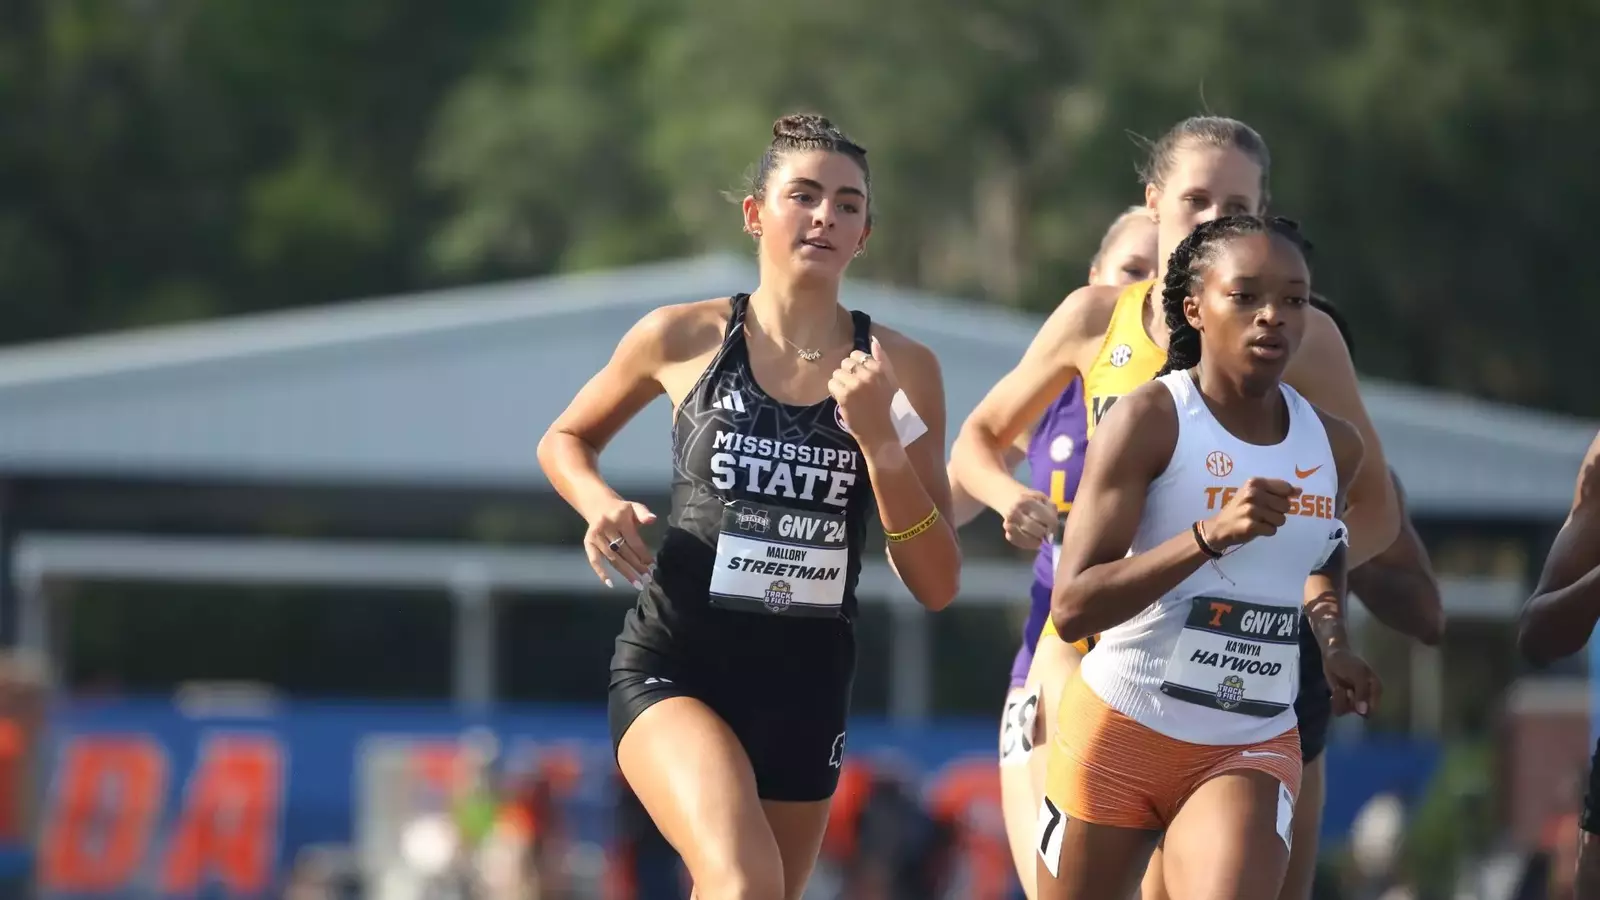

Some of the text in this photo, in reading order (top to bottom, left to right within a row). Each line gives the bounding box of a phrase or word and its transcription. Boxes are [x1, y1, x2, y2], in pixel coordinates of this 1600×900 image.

[712, 430, 857, 471] MISSISSIPPI
[1205, 450, 1234, 478] SEC
[710, 453, 856, 507] STATE
[1204, 486, 1333, 520] TESSEE
[778, 514, 821, 541] GNV
[766, 545, 808, 562] MALLORY
[727, 556, 841, 581] STREETMAN
[765, 590, 791, 600] TRACK
[770, 597, 791, 606] FIELD
[1240, 609, 1277, 635] GNV
[1189, 648, 1283, 677] HAYWOOD
[1217, 684, 1244, 696] TRACK
[1222, 692, 1243, 702] FIELD
